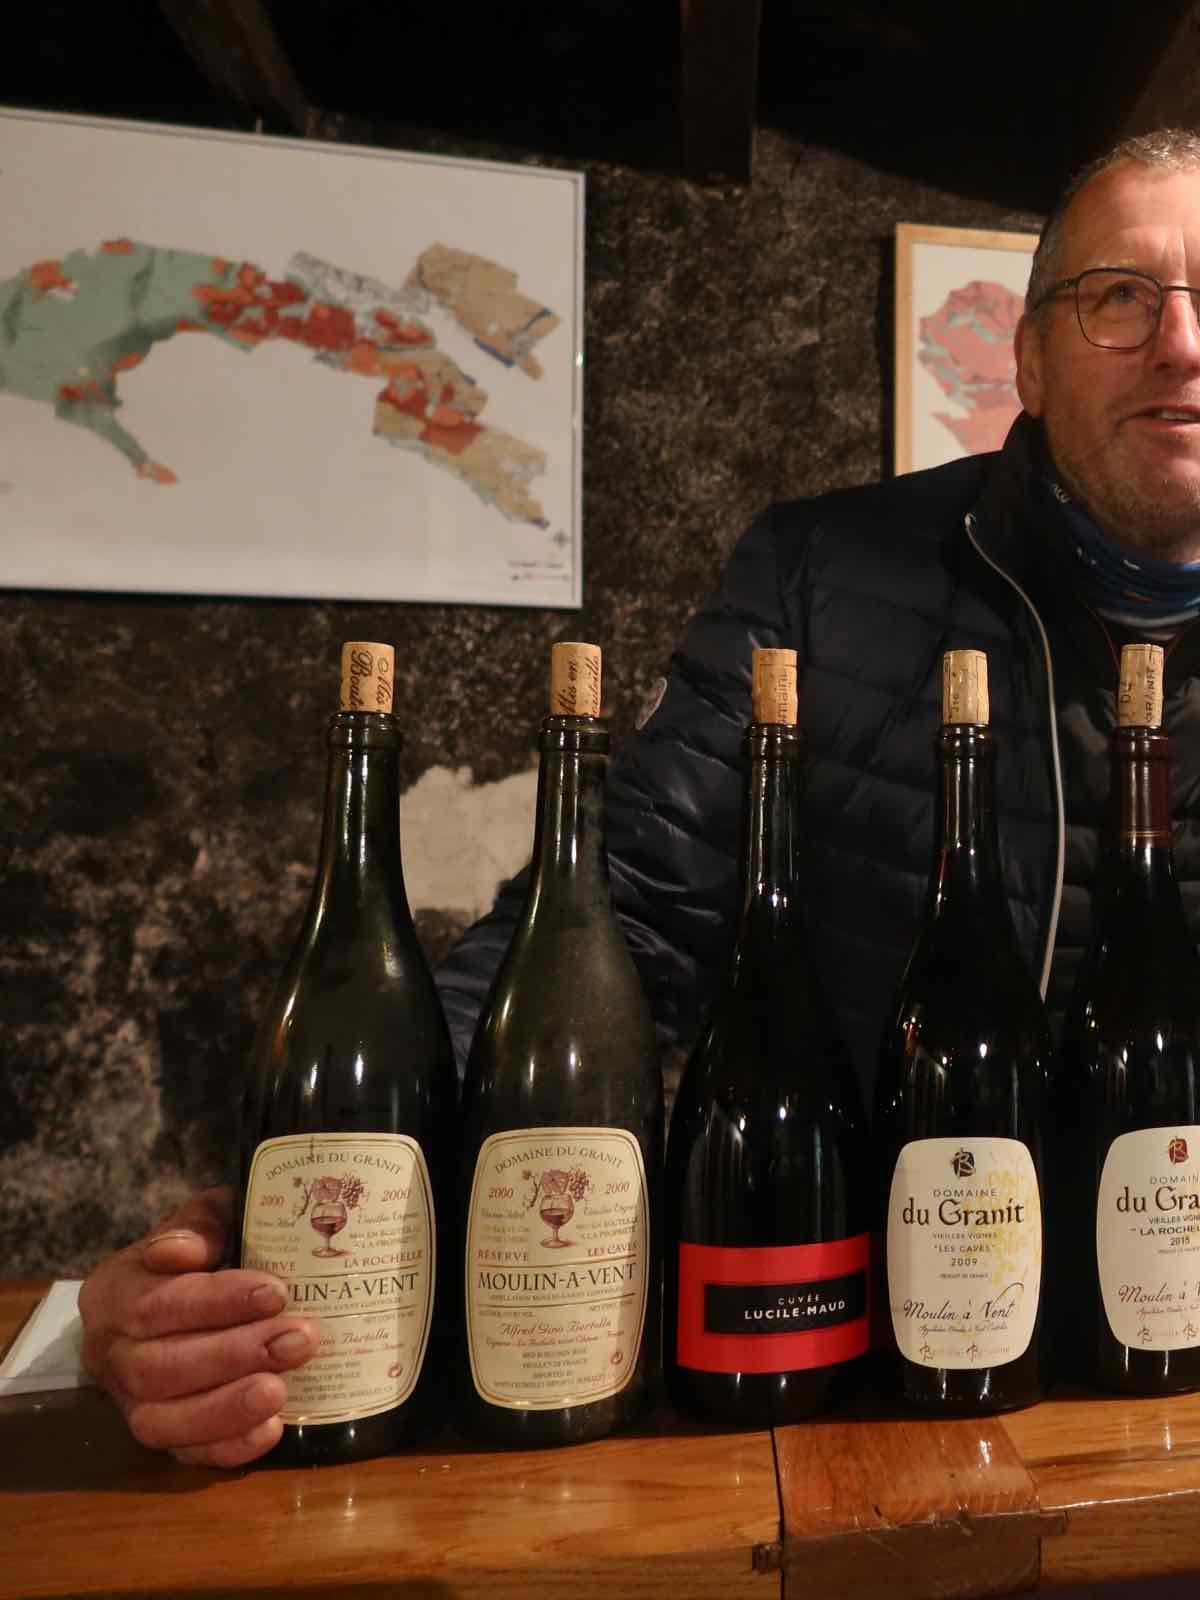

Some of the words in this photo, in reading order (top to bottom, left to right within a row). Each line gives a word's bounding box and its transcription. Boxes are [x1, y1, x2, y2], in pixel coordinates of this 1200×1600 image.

[265, 1152, 325, 1181] DOMAINE
[328, 1152, 347, 1163] DU
[353, 1152, 402, 1175] GRANIT
[495, 1147, 553, 1174] DOMAINE
[557, 1146, 576, 1156] DU
[579, 1146, 624, 1169] GRANIT
[383, 1187, 411, 1201] 2000
[488, 1187, 514, 1200] 2000
[606, 1182, 630, 1195] 2000
[933, 1188, 998, 1198] DOMAINE
[1116, 1186, 1147, 1213] du
[902, 1196, 930, 1226] du
[938, 1198, 1025, 1226] Granit
[344, 1260, 359, 1269] LA
[362, 1250, 423, 1267] ROCHELLE
[951, 1258, 978, 1267] 2009
[478, 1263, 637, 1291] MOULIN-A-VENT
[287, 1272, 419, 1303] LIN-A-VENT
[1118, 1282, 1172, 1304] Moulin
[777, 1293, 820, 1306] CUVÉE
[903, 1299, 960, 1321] Moulin
[983, 1289, 1022, 1321] Vent
[744, 1300, 846, 1320] LUCILE-MAUD
[501, 1321, 536, 1336] Alfred
